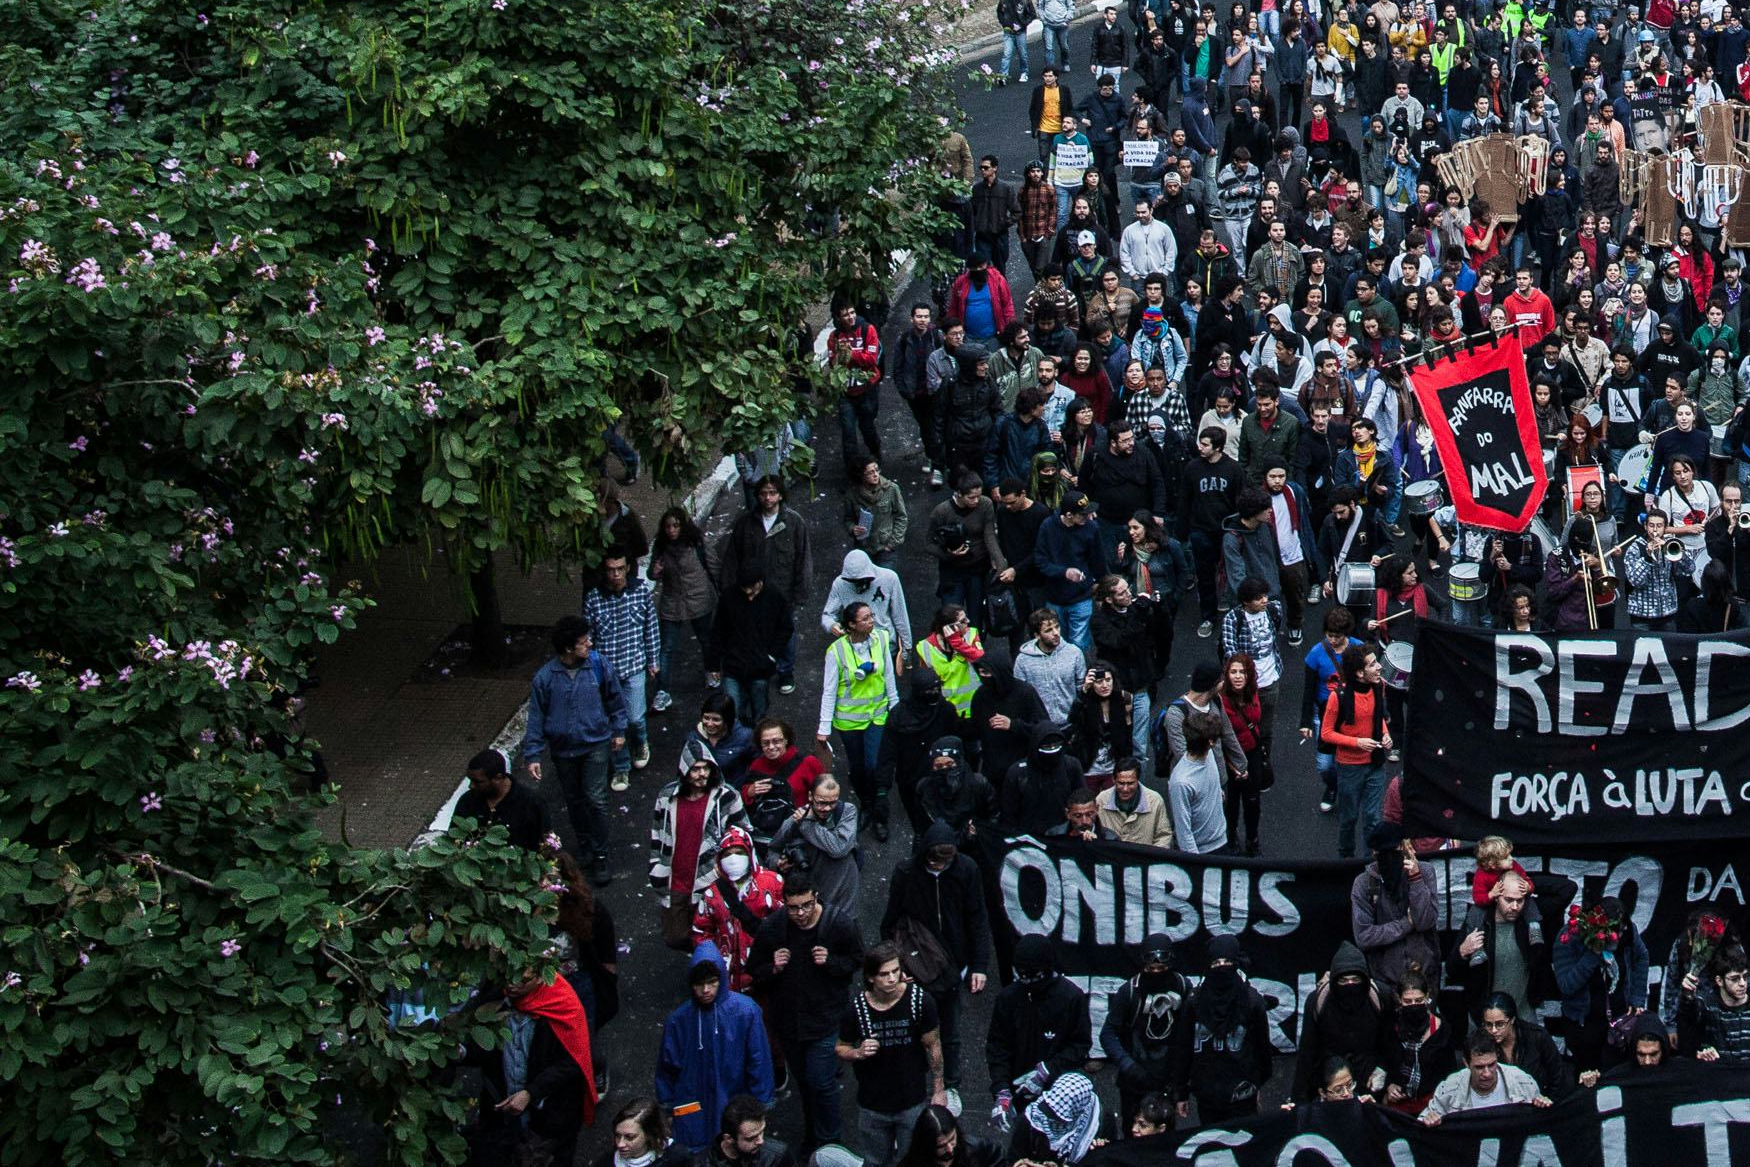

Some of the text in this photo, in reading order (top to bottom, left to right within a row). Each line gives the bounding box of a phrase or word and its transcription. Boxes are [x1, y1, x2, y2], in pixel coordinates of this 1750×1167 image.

[1447, 386, 1516, 436] FANFARRA
[1476, 431, 1493, 448] DO
[1199, 476, 1229, 493] GAP
[1470, 451, 1536, 499] MAL
[1491, 770, 1591, 823] FORÇA
[1602, 767, 1633, 810] à
[1633, 767, 1733, 816] LUTA
[1001, 834, 1303, 947] ÔNIBUS
[1686, 863, 1747, 907] DA
